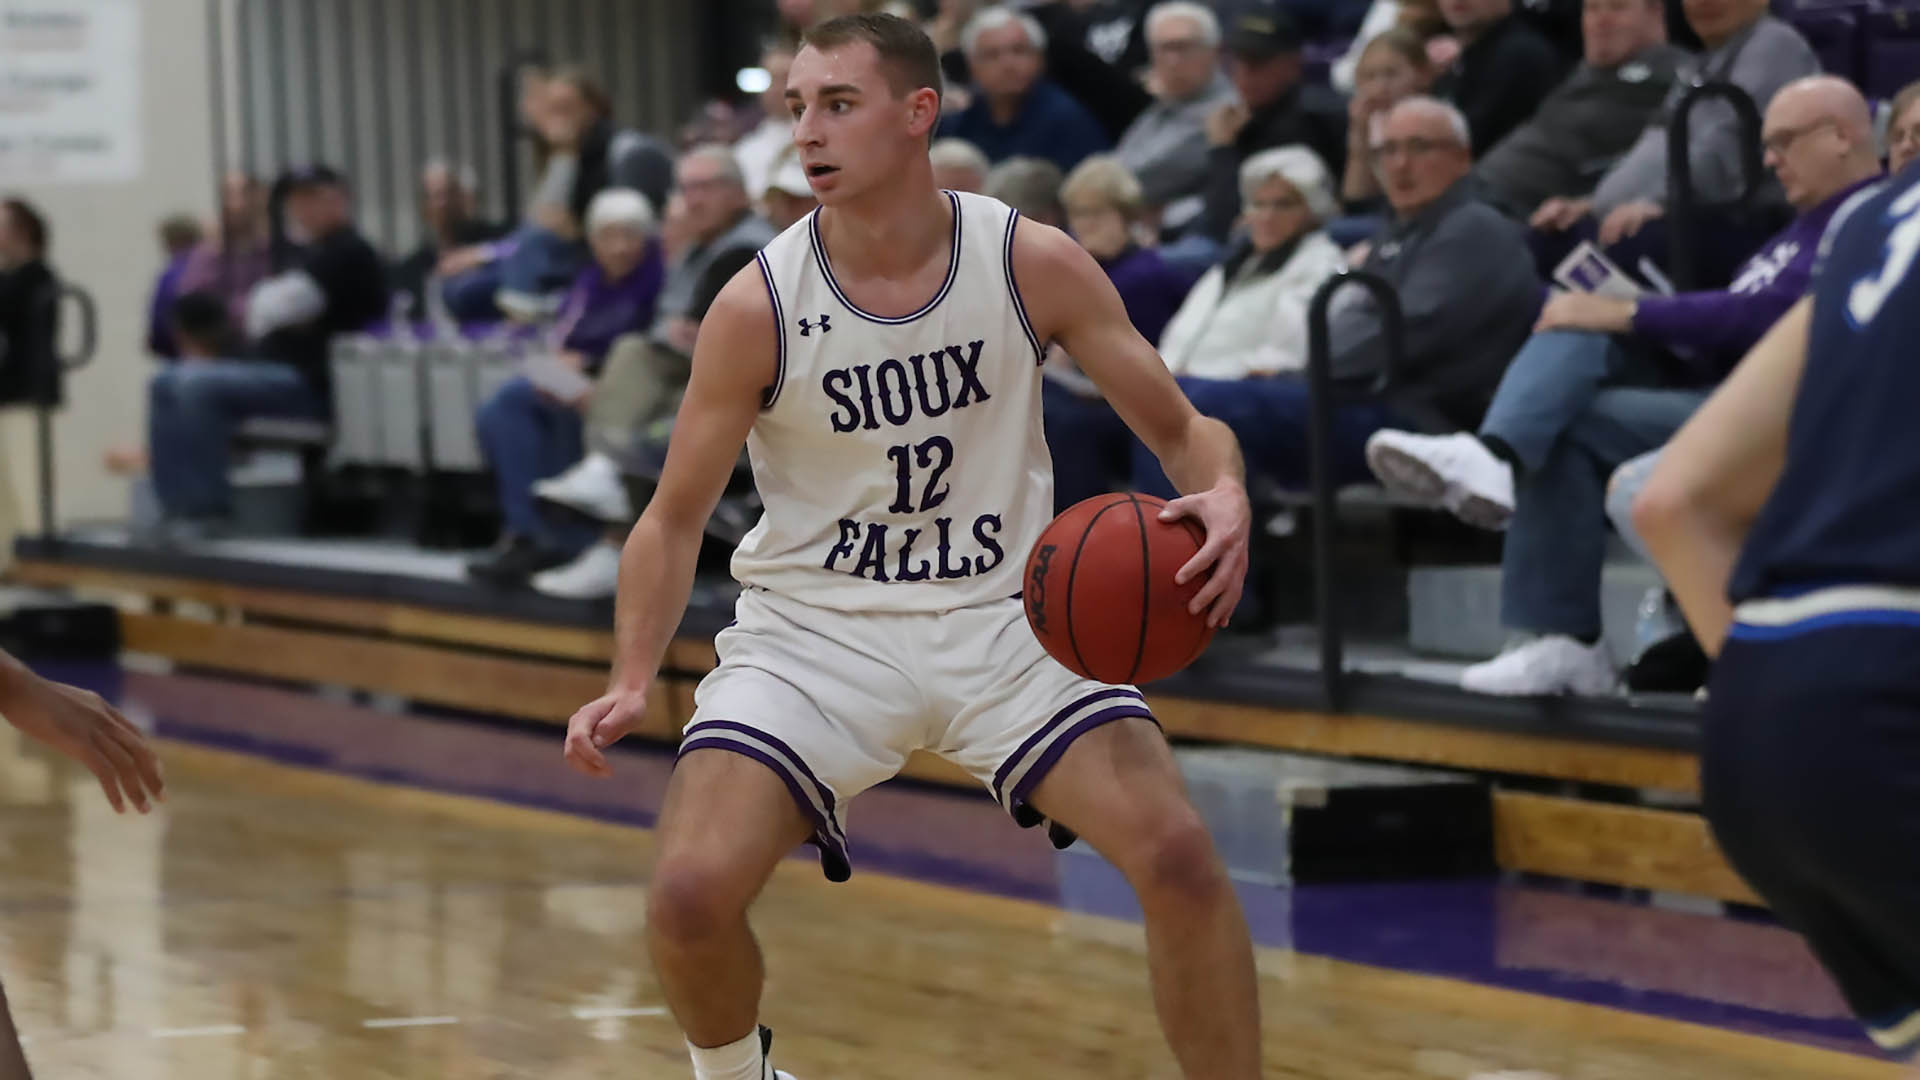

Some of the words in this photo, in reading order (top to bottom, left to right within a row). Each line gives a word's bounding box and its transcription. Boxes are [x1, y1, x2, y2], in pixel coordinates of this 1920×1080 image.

[822, 340, 991, 433] SIOUX
[887, 435, 954, 514] 12
[822, 513, 1004, 582] FALLS
[1029, 544, 1057, 634] NCAA
